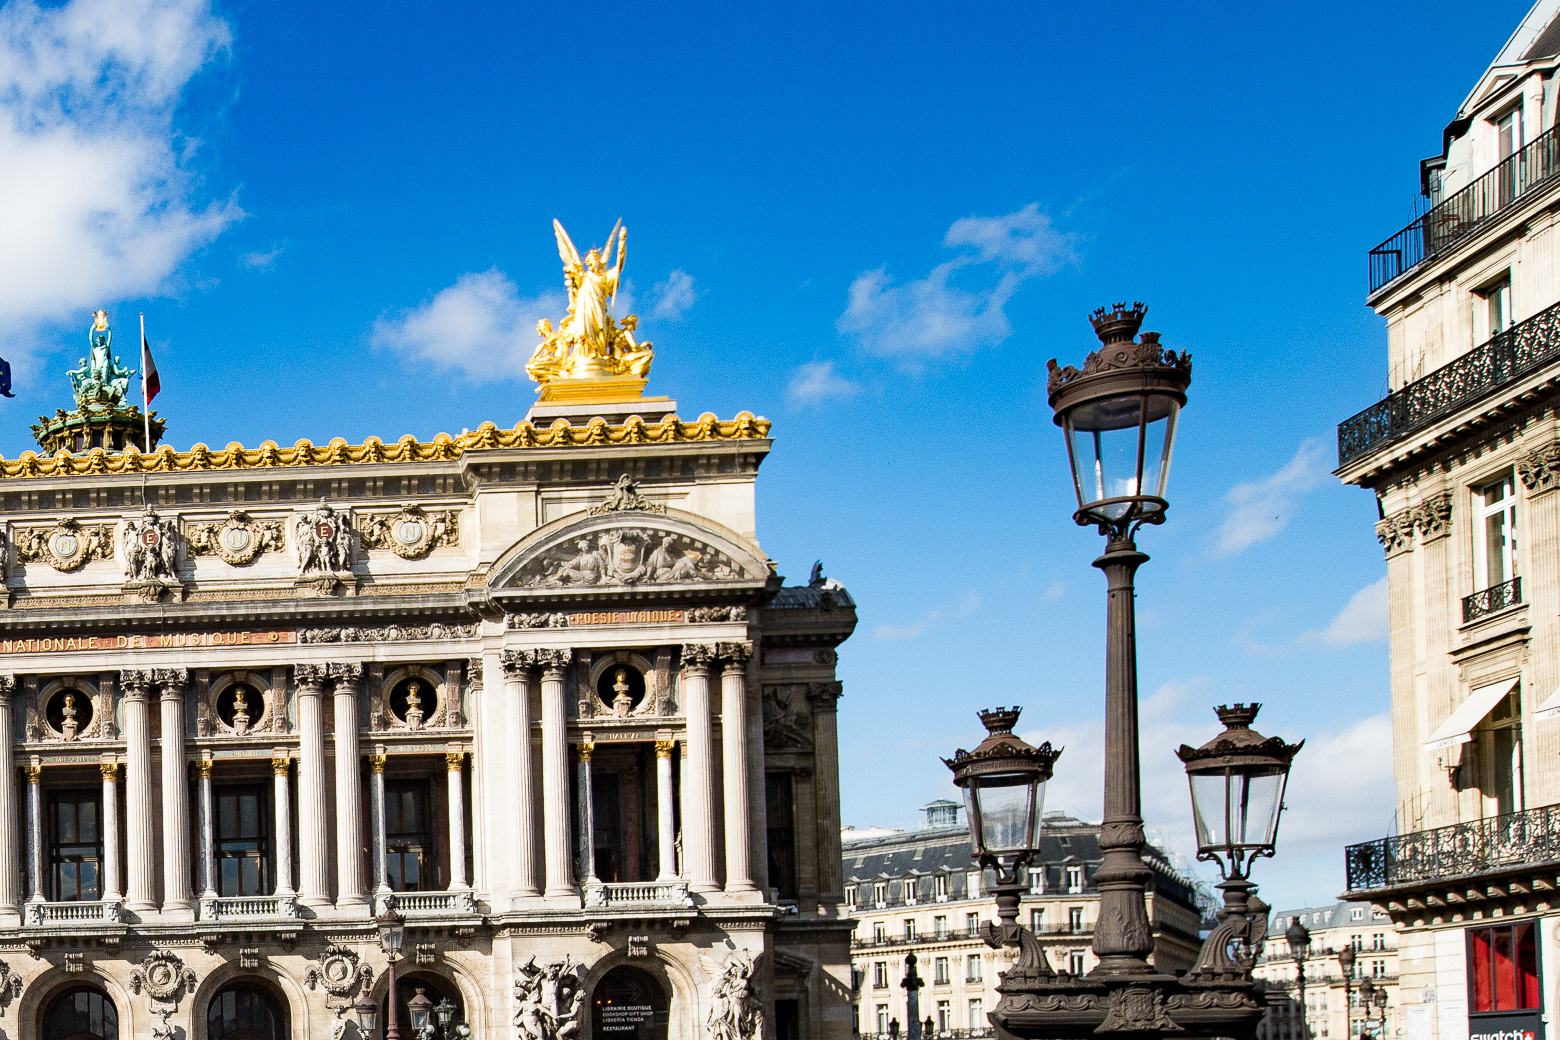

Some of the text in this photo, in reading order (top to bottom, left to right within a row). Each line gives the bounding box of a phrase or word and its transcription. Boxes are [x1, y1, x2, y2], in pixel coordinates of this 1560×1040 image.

[576, 610, 676, 625] POESIE LYRIQUE
[2, 636, 99, 653] NATIONALE
[117, 635, 142, 648] DE
[160, 631, 251, 648] MUSIQUE
